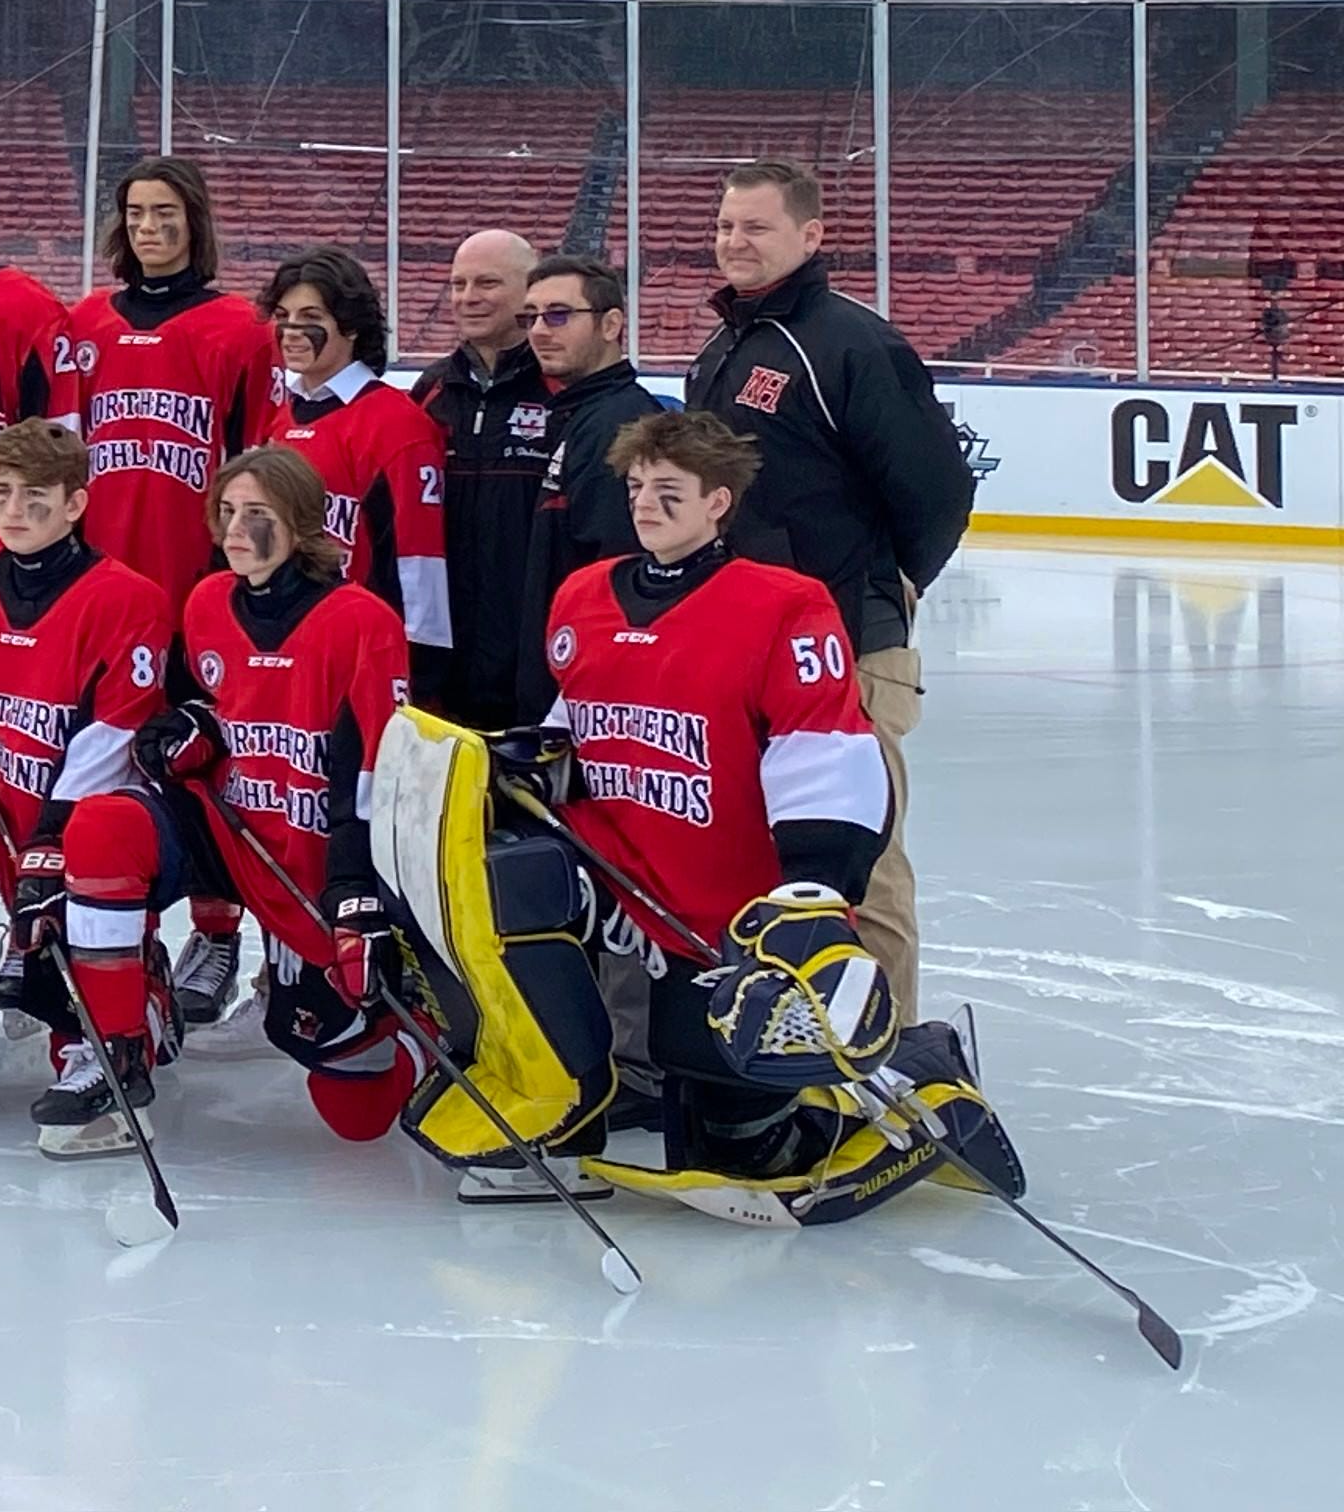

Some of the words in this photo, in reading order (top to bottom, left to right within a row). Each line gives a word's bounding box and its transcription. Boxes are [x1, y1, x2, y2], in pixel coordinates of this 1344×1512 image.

[54, 334, 77, 373] 2
[1111, 398, 1298, 509] CAT
[419, 465, 444, 504] 2
[791, 633, 846, 684] 50
